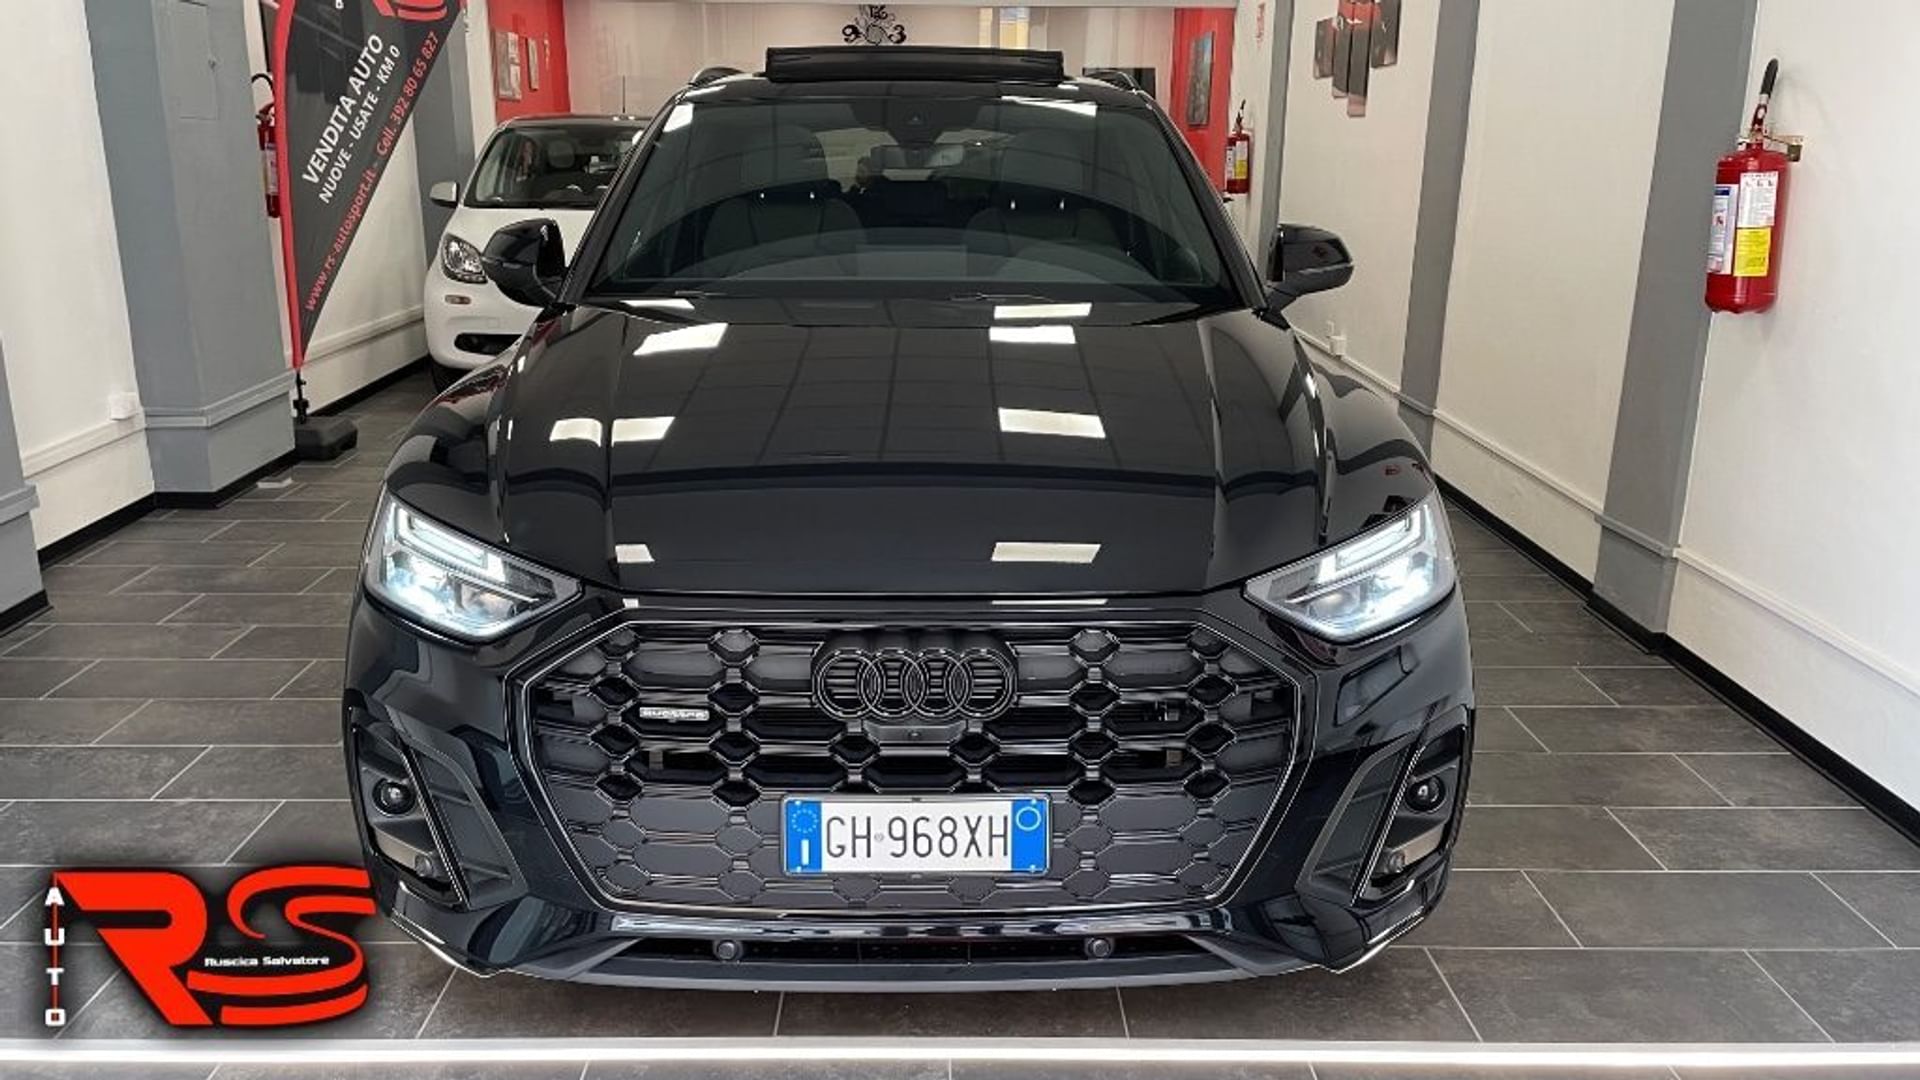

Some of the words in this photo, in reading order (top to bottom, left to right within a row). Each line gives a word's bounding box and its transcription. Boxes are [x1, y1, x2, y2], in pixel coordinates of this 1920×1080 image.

[390, 97, 410, 125] 392
[403, 76, 418, 97] 80
[412, 58, 427, 78] 65
[421, 30, 438, 59] 827
[842, 24, 861, 43] 9
[888, 24, 907, 44] 3
[302, 95, 357, 184] VENDITA
[349, 34, 384, 95] AUTO
[319, 148, 352, 204] NUOVE
[349, 91, 379, 140] USATE
[376, 56, 395, 84] KM
